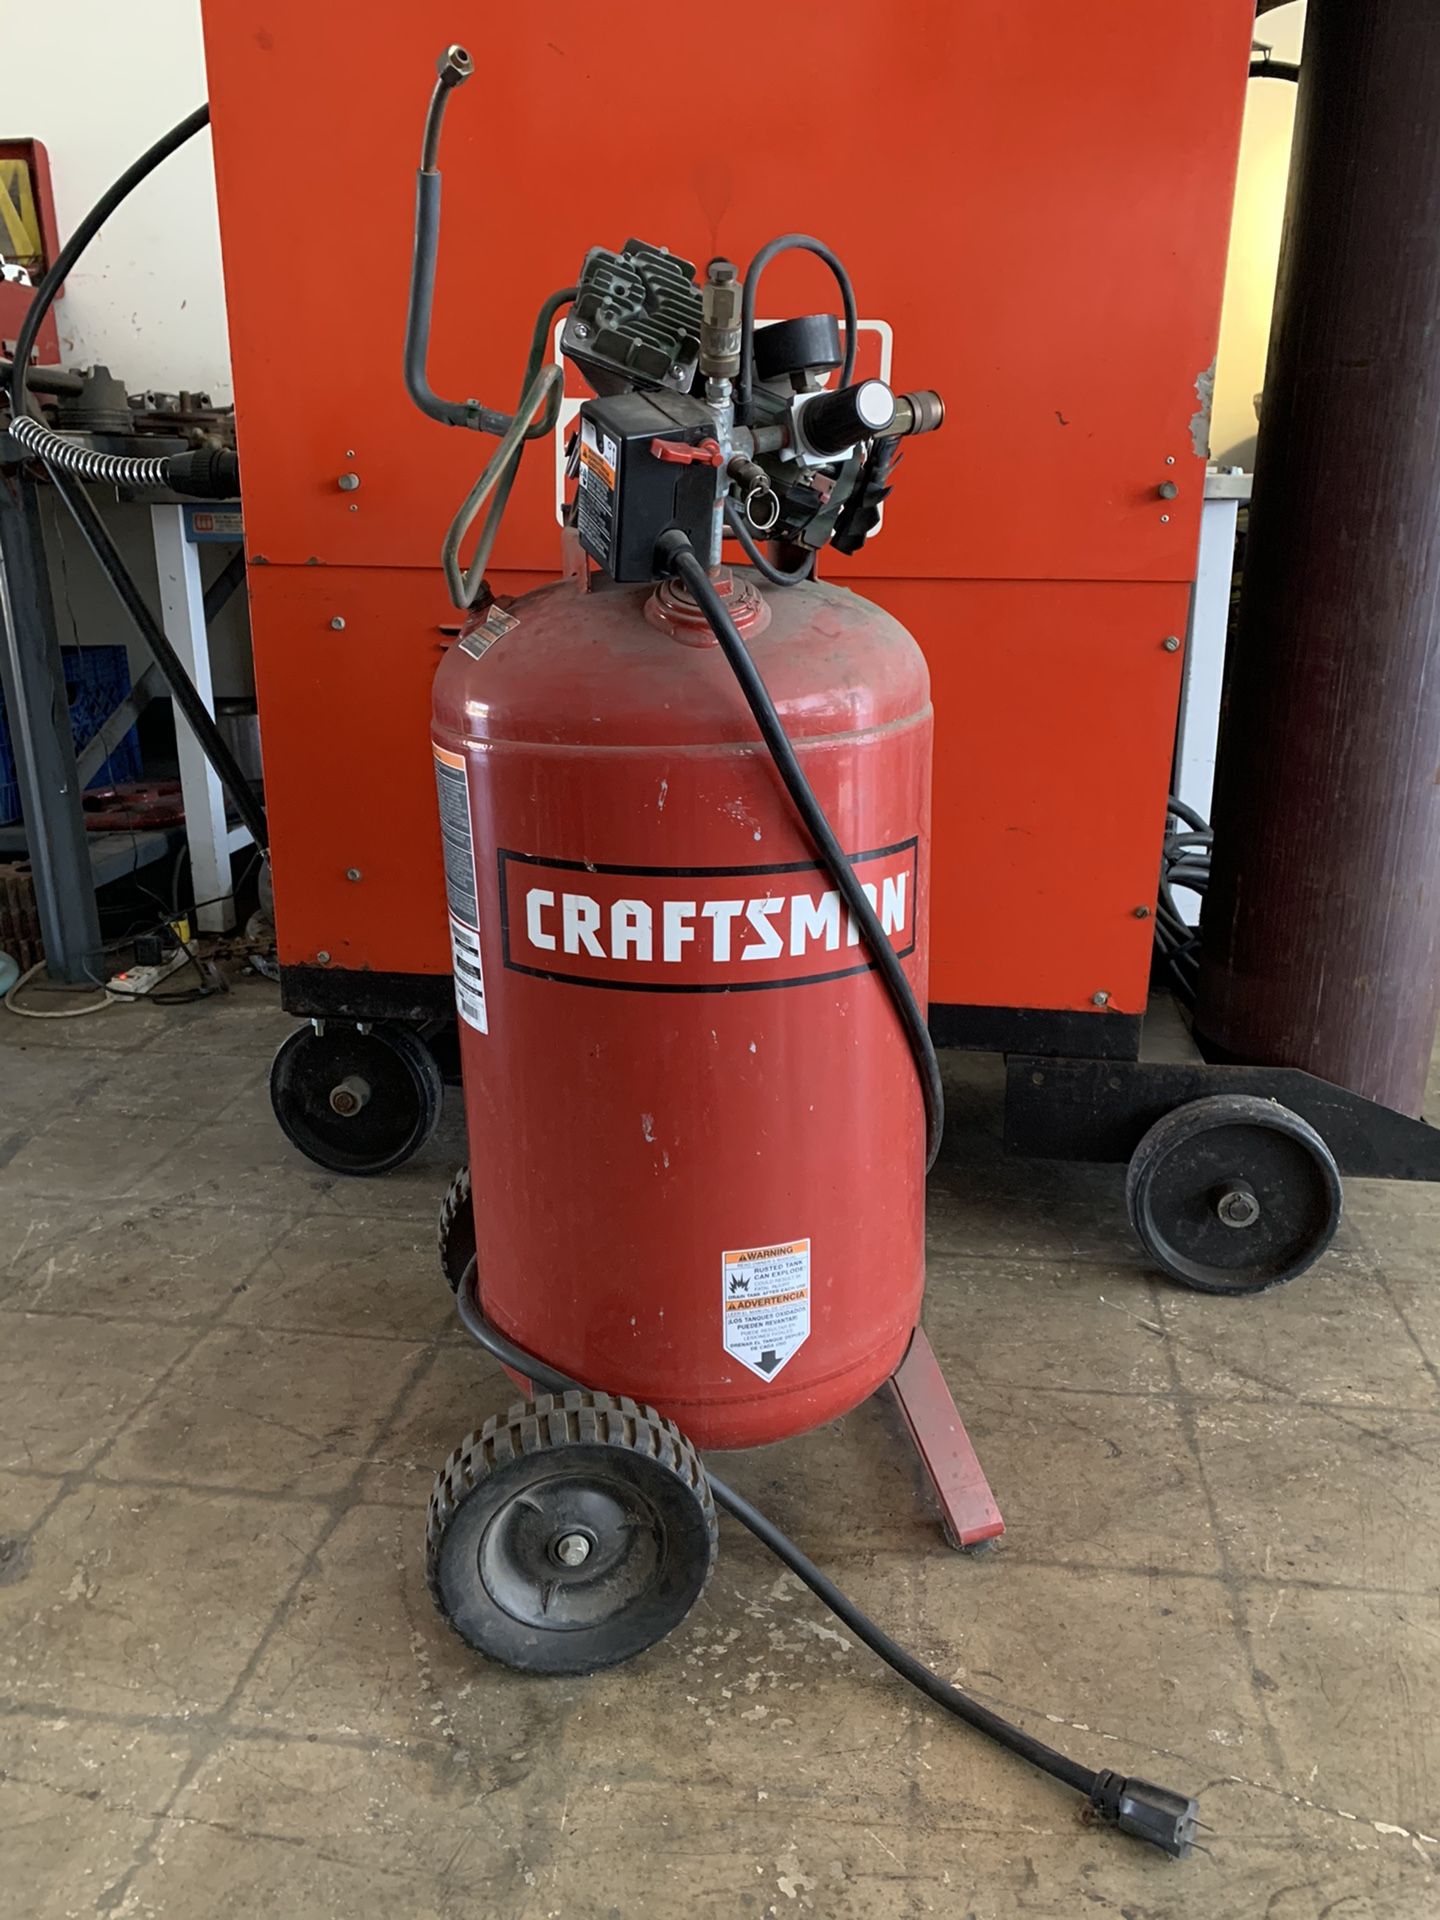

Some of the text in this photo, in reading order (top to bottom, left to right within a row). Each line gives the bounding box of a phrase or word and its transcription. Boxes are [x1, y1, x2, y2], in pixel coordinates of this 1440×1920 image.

[747, 1246, 793, 1260] WARNING
[754, 1264, 783, 1273] RUSTED
[785, 1260, 803, 1268] TANK
[737, 1291, 804, 1309] ADVERTENCIA
[745, 1314, 773, 1322] TANQUES
